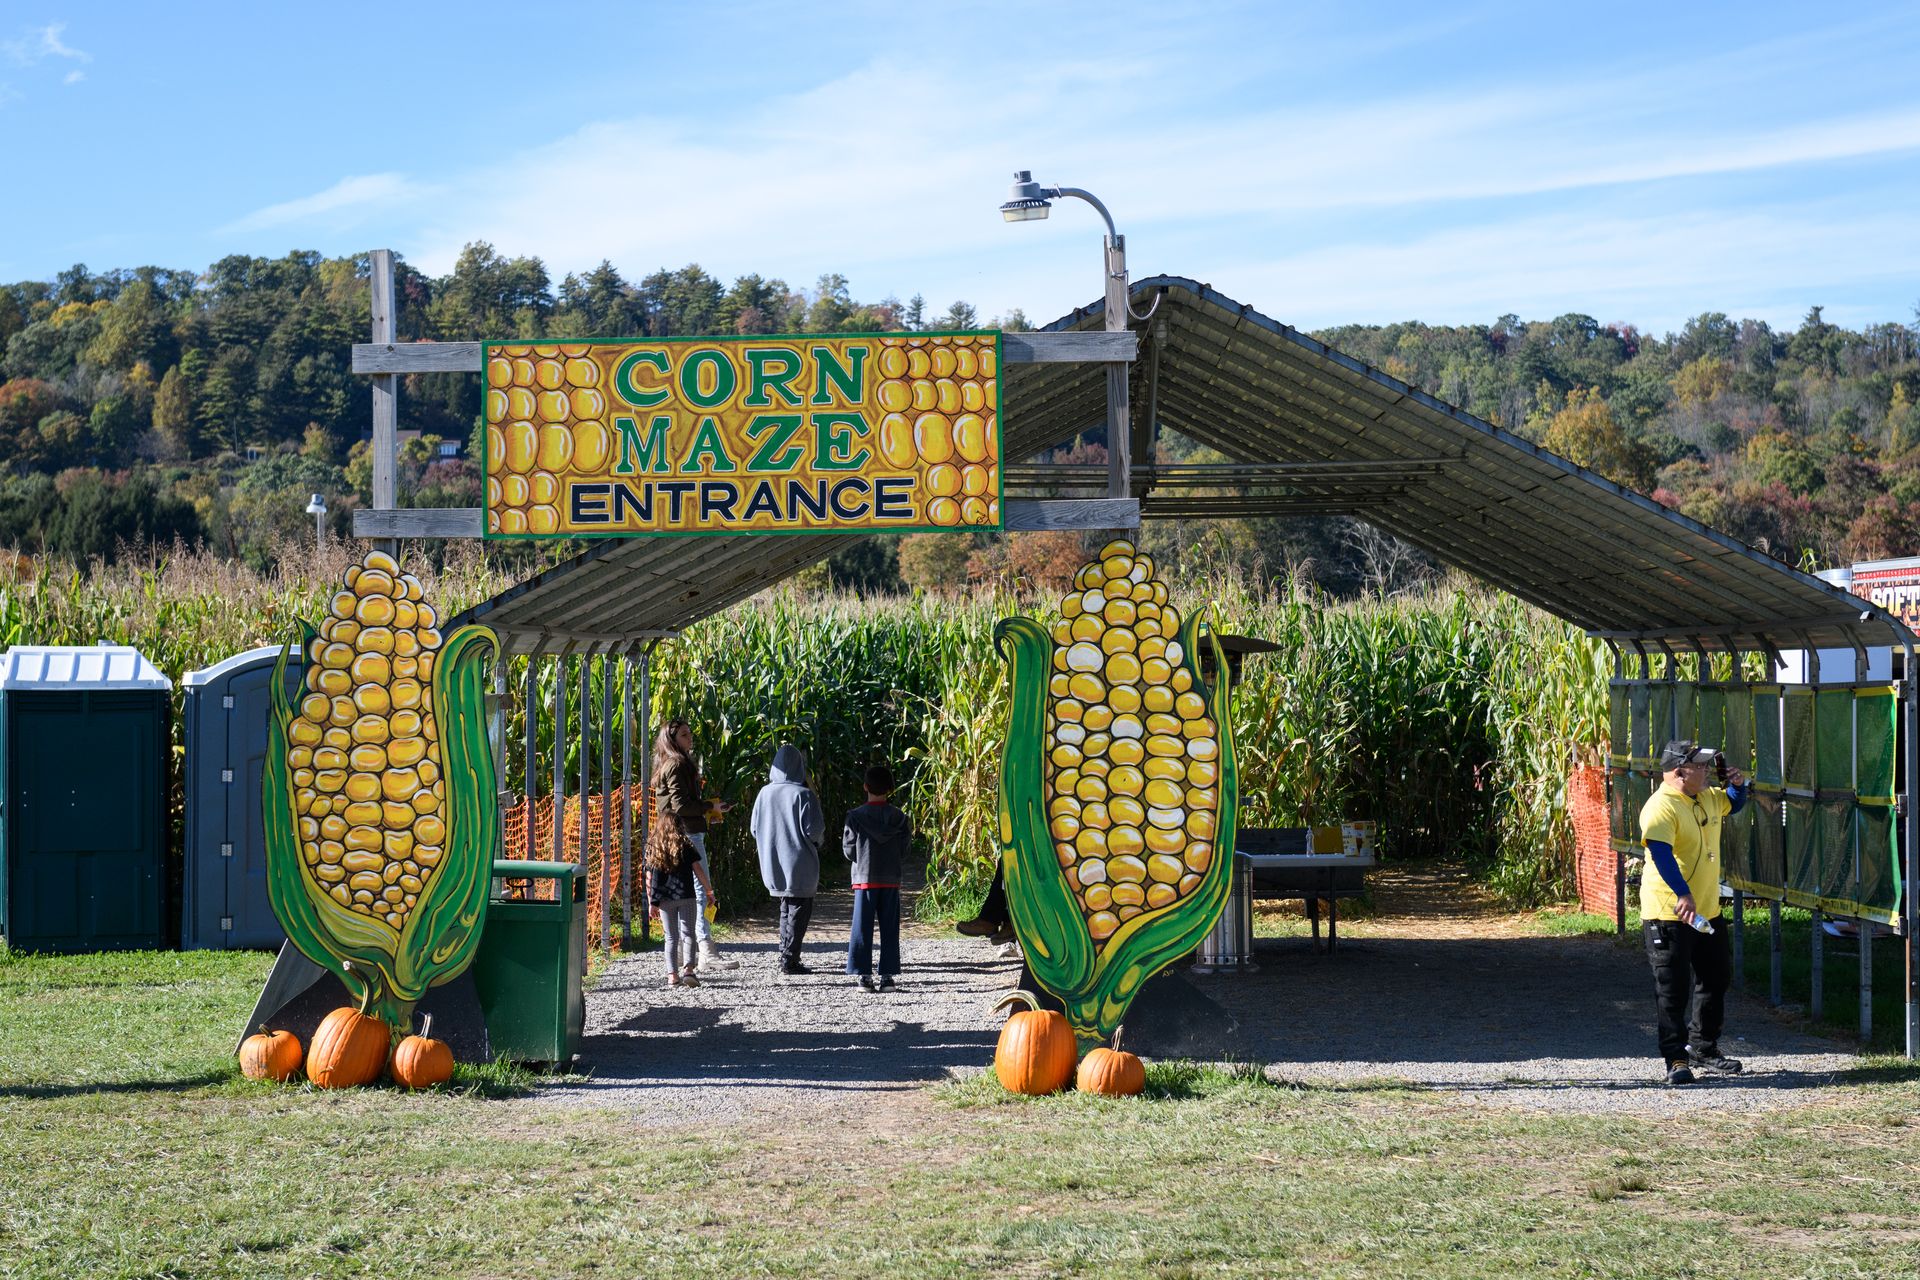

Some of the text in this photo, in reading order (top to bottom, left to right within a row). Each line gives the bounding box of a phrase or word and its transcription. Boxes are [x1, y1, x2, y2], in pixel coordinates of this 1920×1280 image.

[615, 347, 869, 408] CORN
[615, 412, 871, 474] MAZE
[569, 476, 916, 523] ENTRANCE
